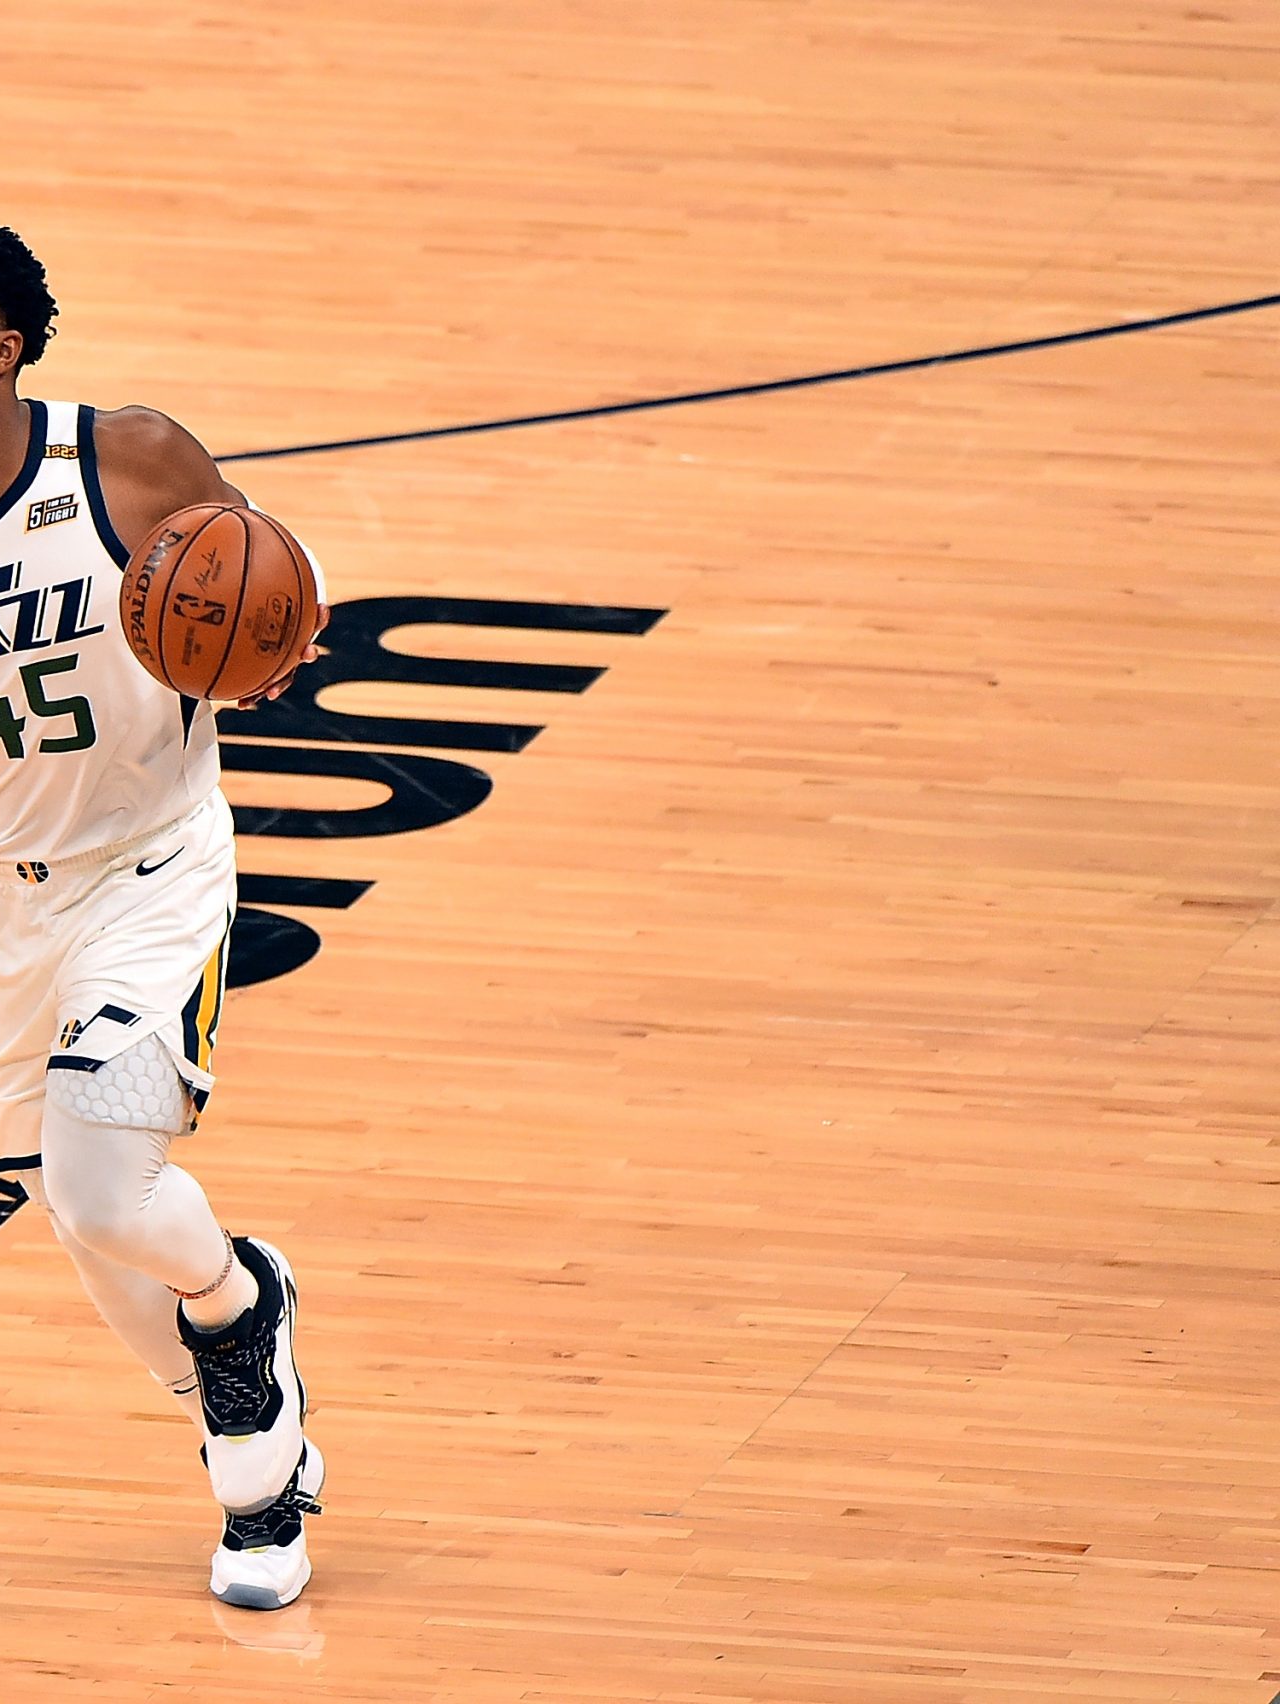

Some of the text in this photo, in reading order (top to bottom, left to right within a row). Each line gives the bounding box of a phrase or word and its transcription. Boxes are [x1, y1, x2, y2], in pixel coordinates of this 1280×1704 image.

[44, 444, 78, 459] 1223
[29, 503, 43, 528] 5
[45, 506, 76, 524] FIGHT
[130, 528, 187, 662] SPALDING
